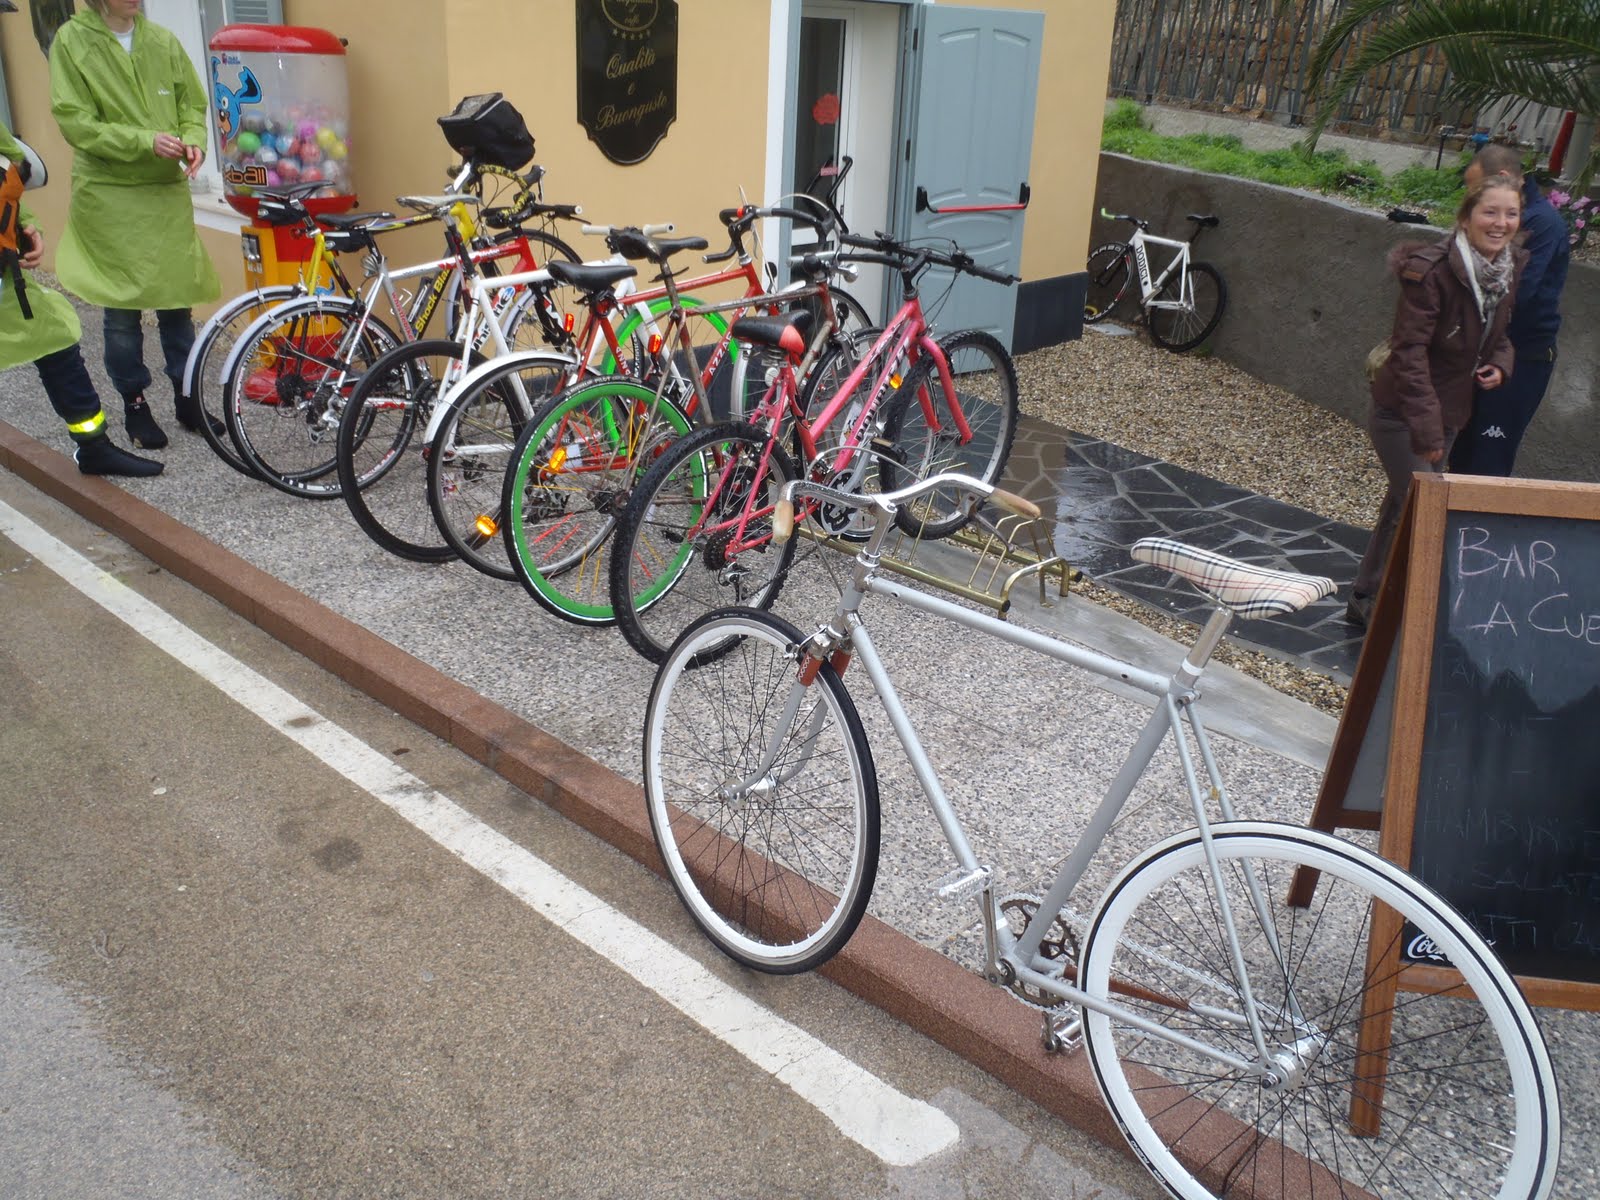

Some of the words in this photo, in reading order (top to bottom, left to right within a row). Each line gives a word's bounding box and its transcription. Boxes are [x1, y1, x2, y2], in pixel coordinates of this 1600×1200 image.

[627, 81, 636, 95] e
[595, 90, 668, 131] Buongusto
[1136, 245, 1149, 281] DODICI
[414, 294, 438, 333] Shock
[433, 268, 450, 294] Bla
[1458, 527, 1560, 584] BAR
